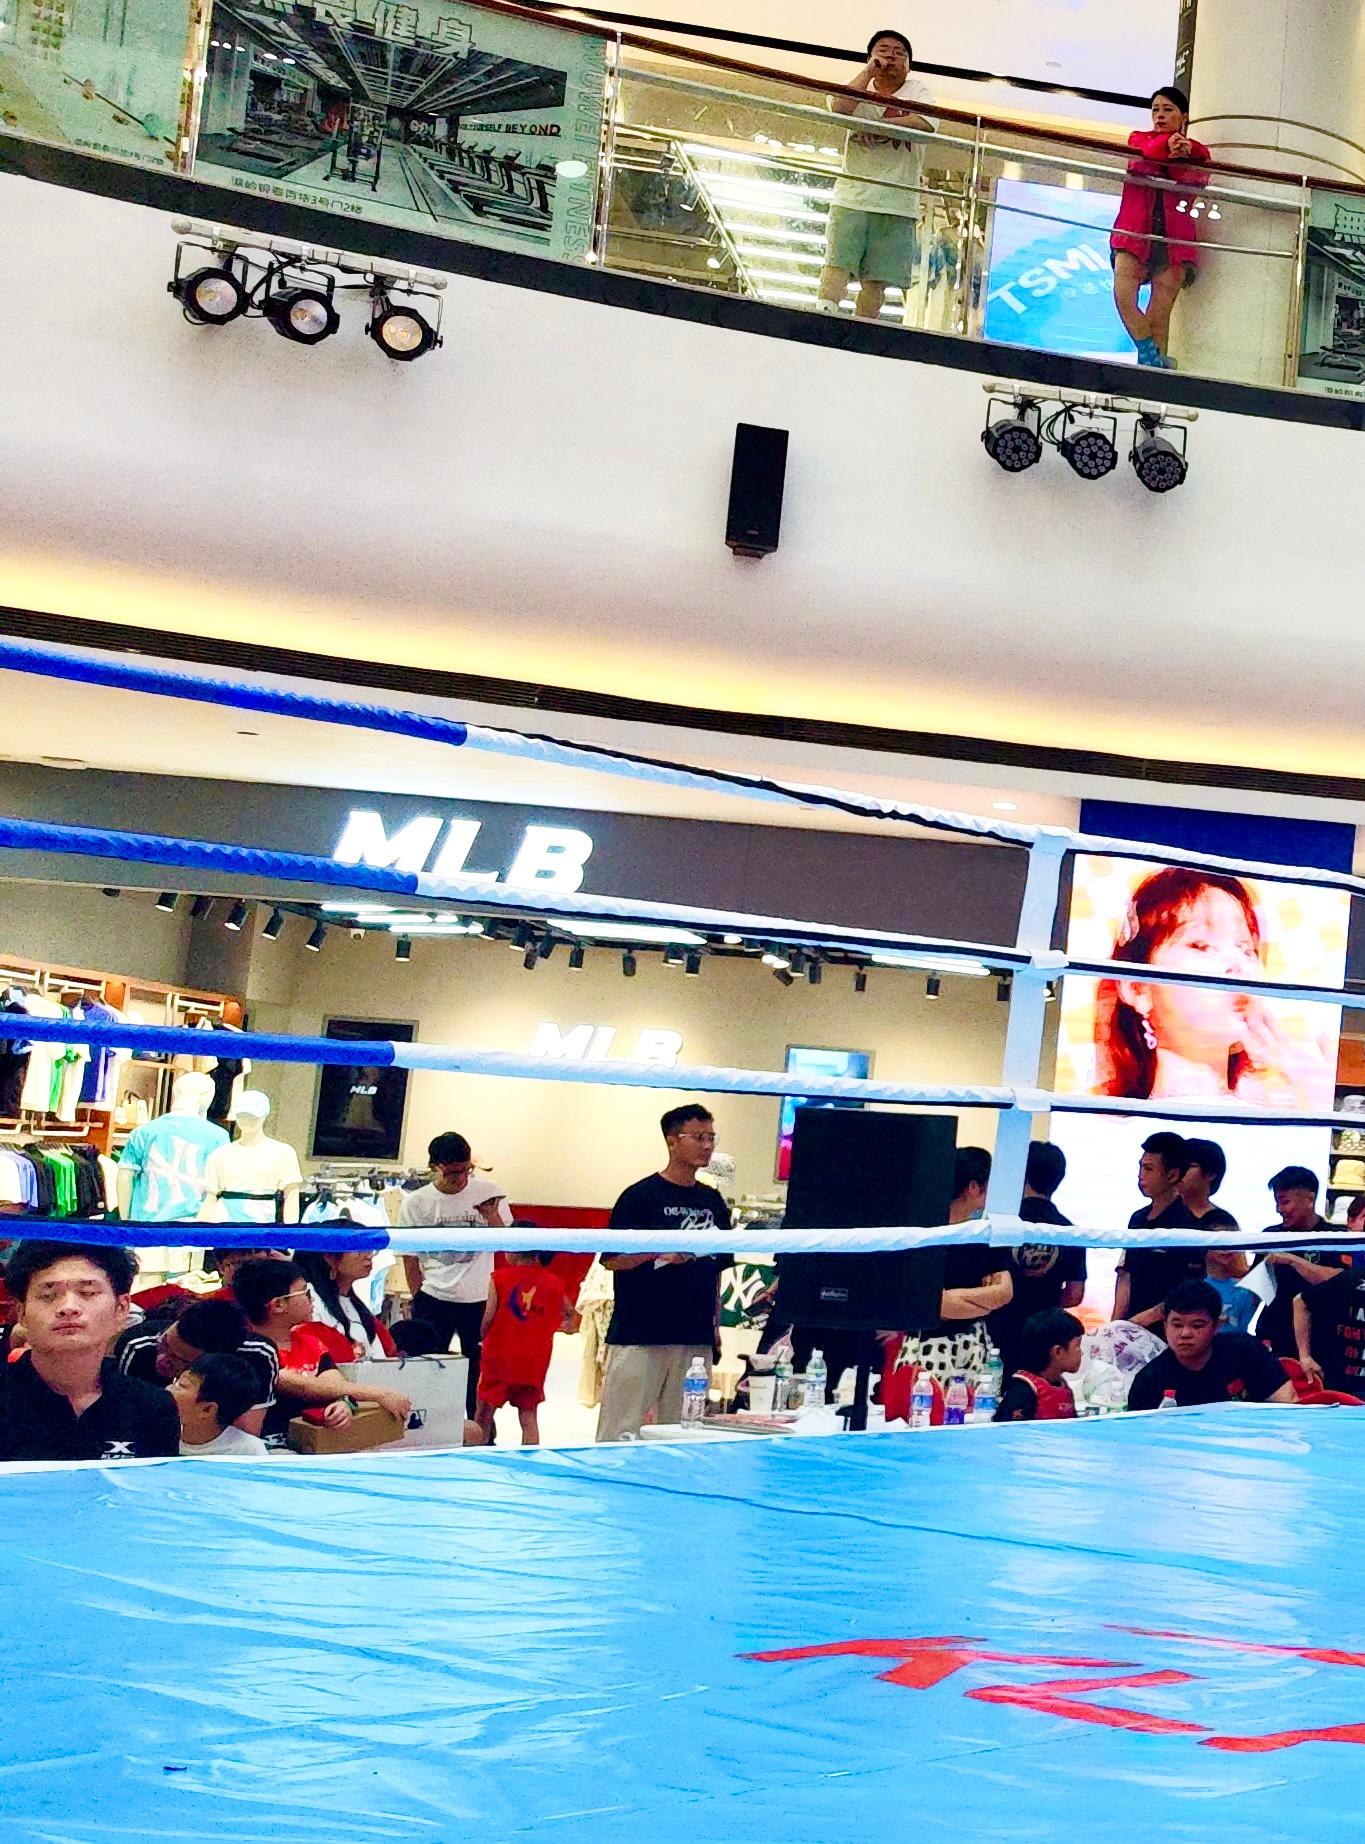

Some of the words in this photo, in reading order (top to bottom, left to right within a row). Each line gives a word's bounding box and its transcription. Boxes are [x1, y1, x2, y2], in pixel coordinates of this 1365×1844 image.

[504, 123, 562, 137] BEYOND
[332, 808, 595, 895] MLB
[527, 1021, 684, 1068] MLB
